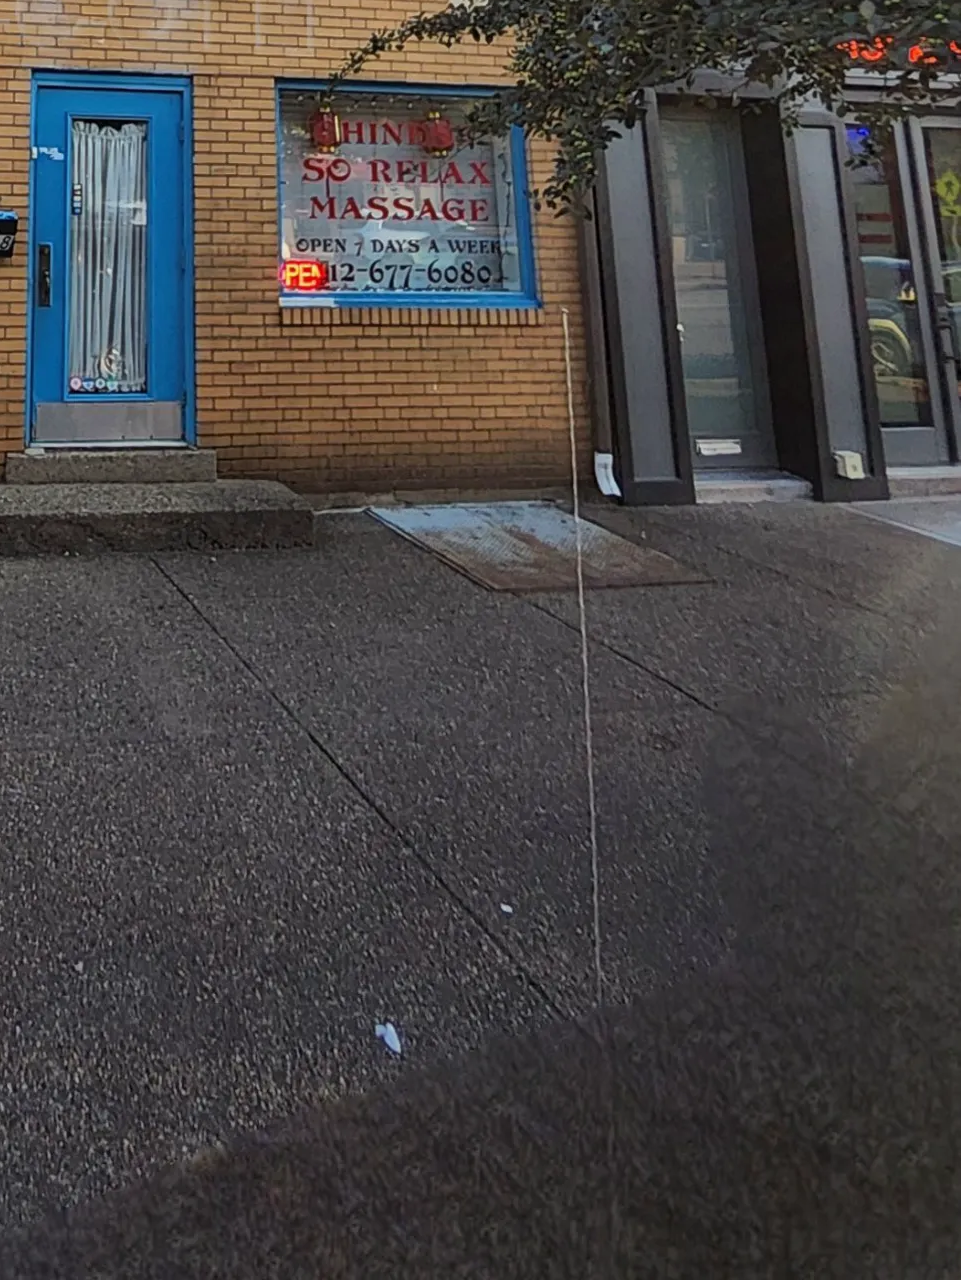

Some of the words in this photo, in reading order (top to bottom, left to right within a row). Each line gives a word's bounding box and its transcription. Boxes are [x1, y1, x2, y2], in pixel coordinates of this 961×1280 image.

[302, 157, 352, 182] SO
[368, 158, 491, 185] RELAX
[309, 196, 489, 222] MASSAGE
[296, 238, 347, 253] OPEN
[354, 241, 364, 257] 7
[371, 238, 420, 254] DAYS
[428, 239, 440, 254] A
[447, 239, 502, 255] WEEK
[326, 259, 492, 291] 12-677-6080
